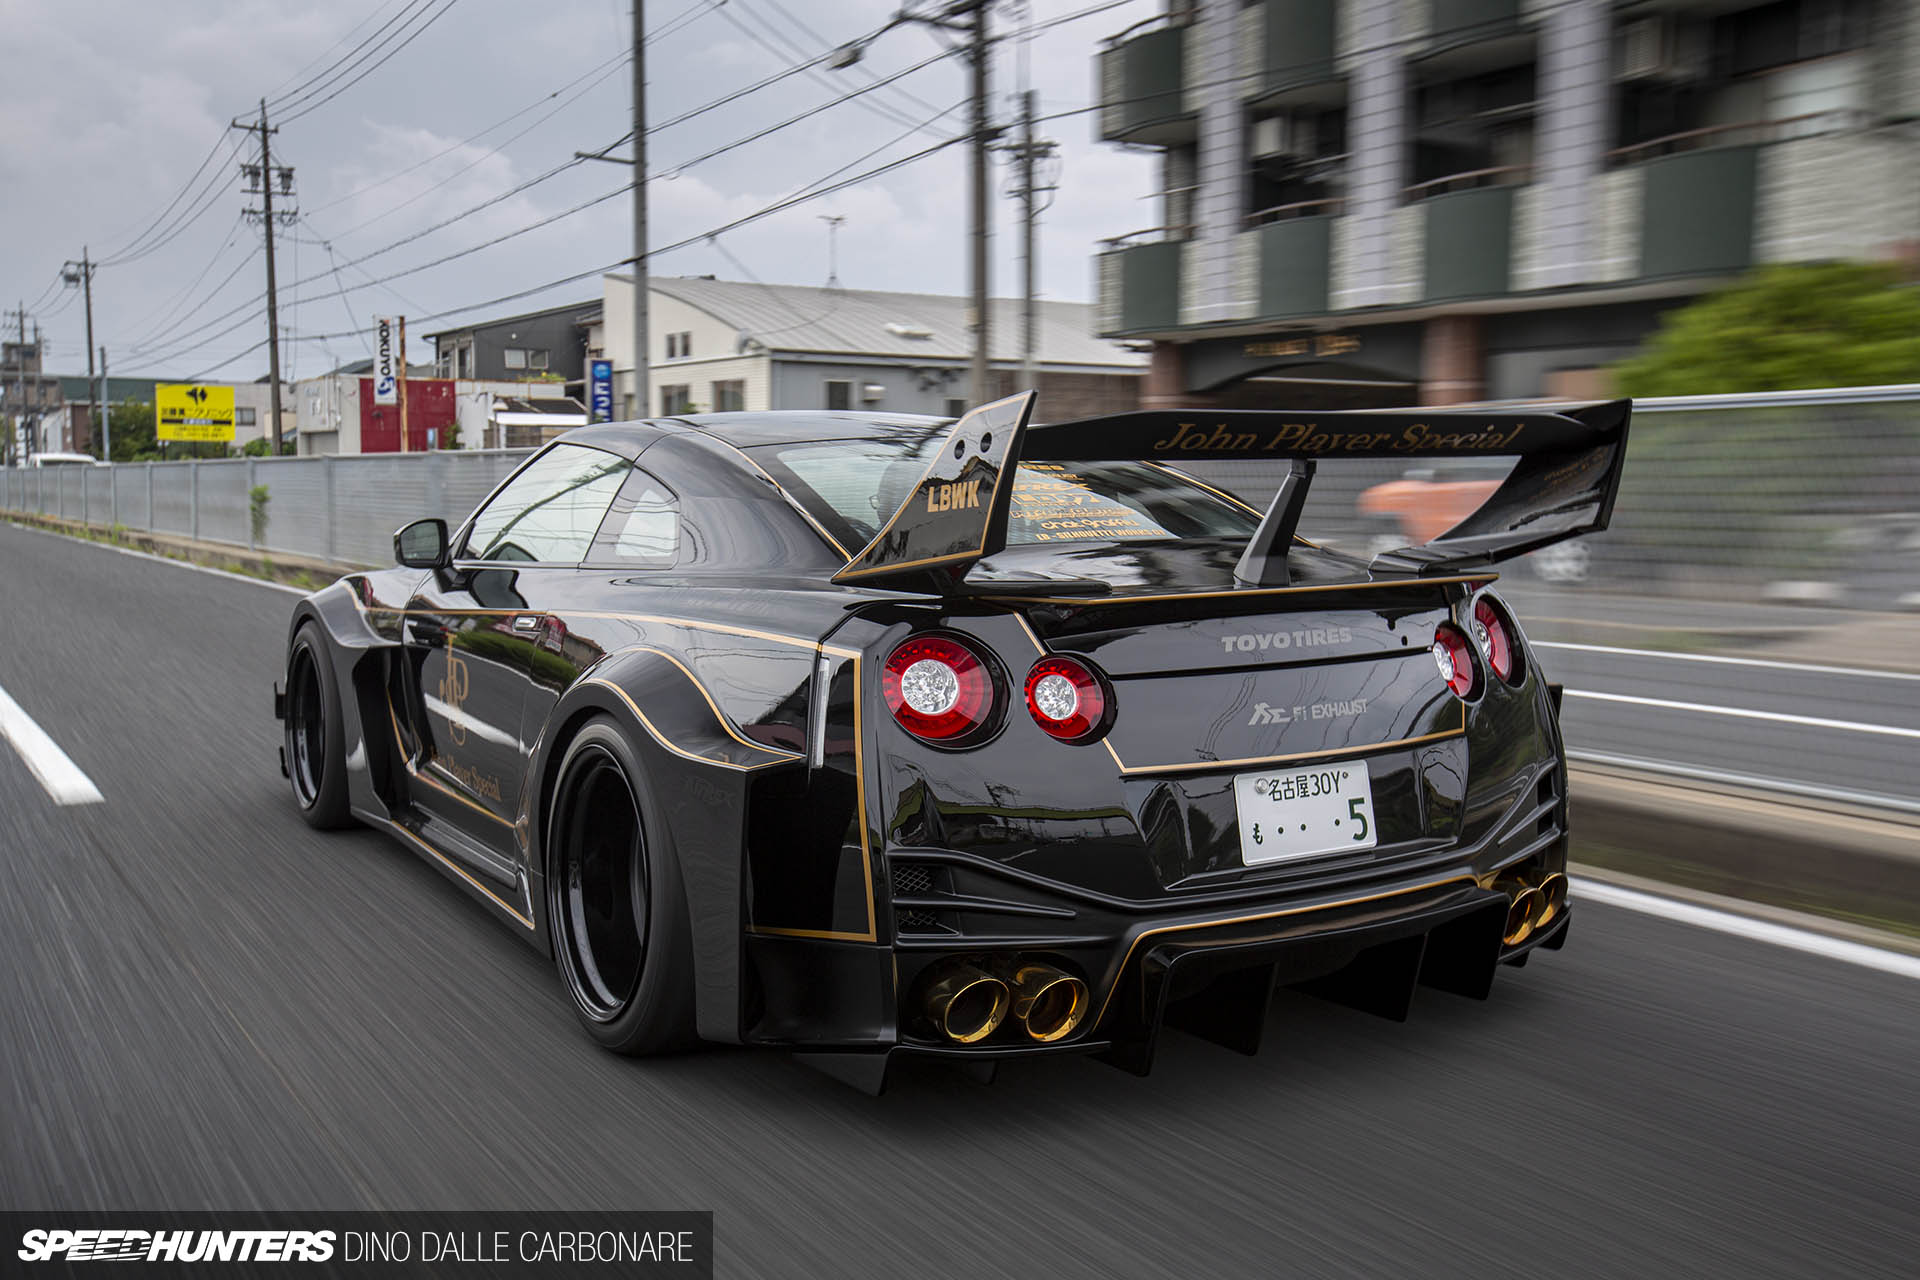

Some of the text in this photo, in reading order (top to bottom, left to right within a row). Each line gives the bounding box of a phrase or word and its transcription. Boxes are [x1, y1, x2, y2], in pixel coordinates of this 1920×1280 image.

[1153, 423, 1525, 453] John Player Special
[927, 480, 980, 512] LBWK
[1221, 627, 1353, 653] TOYO TIRES
[1311, 699, 1368, 720] EXHAUST
